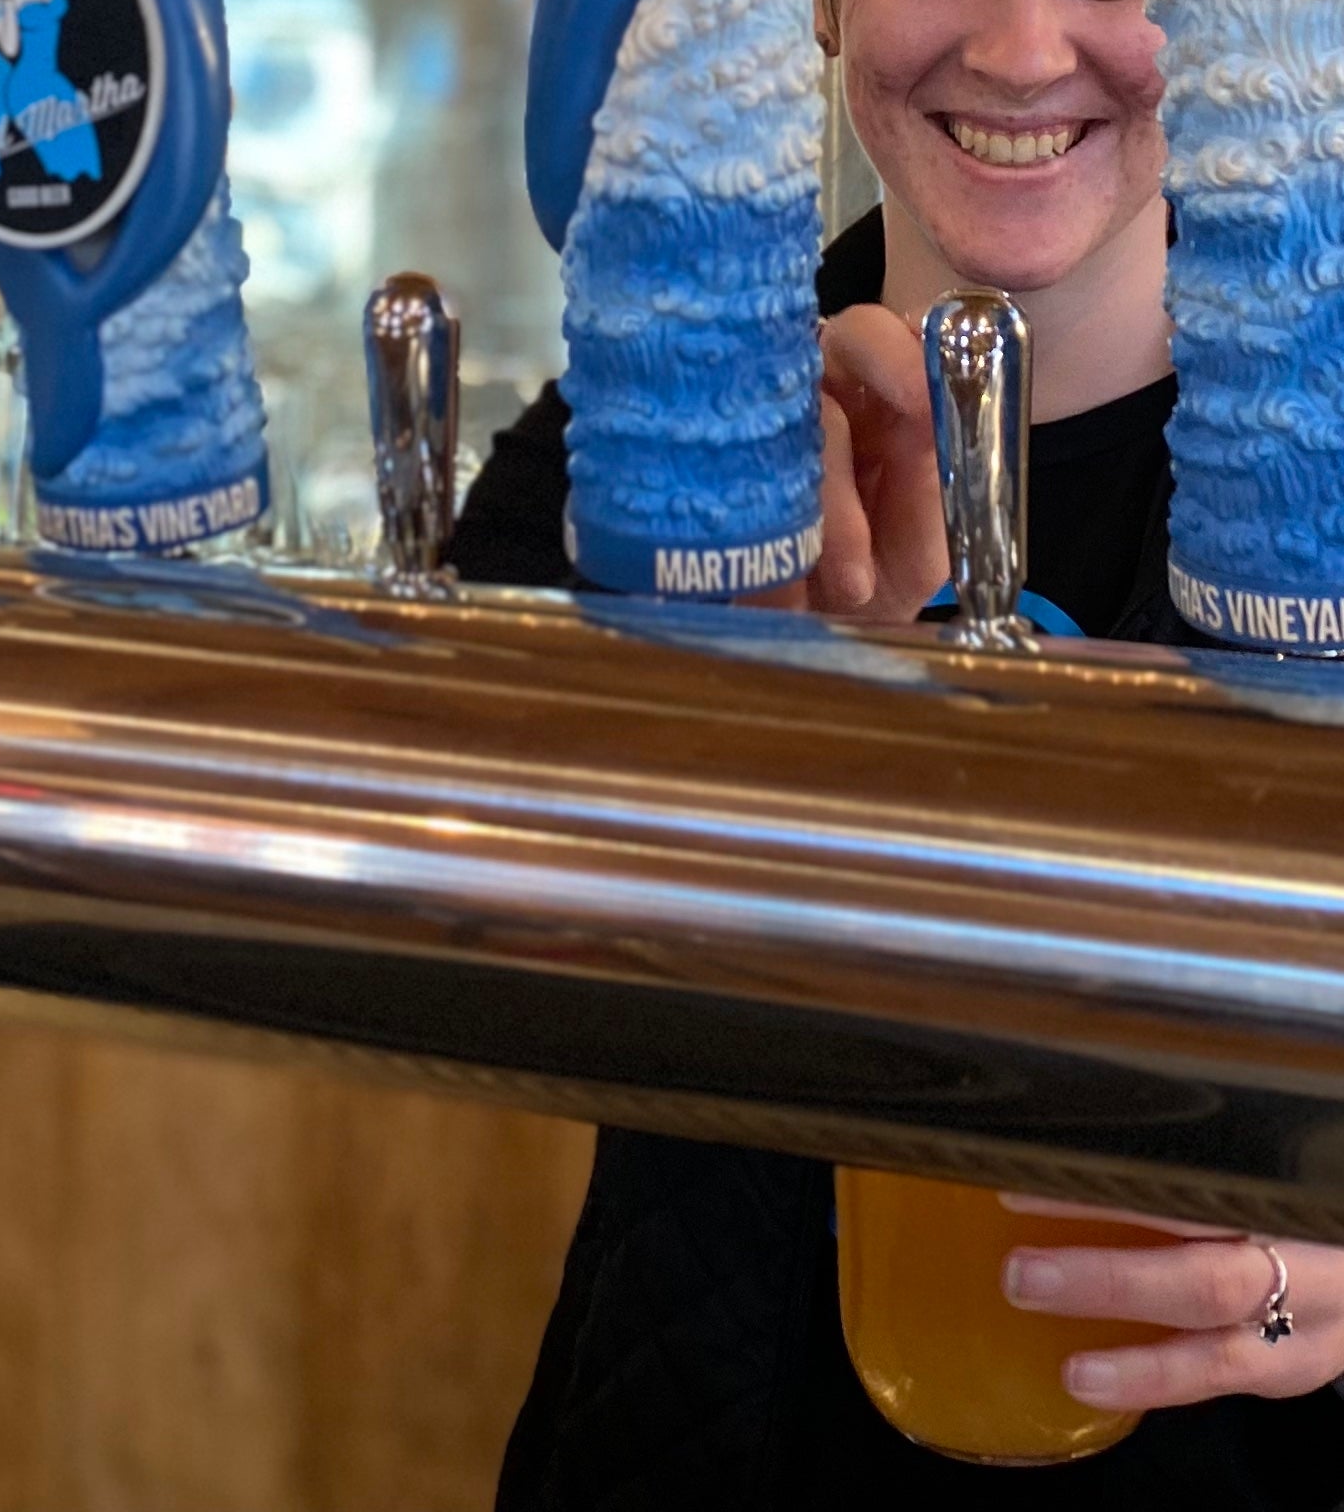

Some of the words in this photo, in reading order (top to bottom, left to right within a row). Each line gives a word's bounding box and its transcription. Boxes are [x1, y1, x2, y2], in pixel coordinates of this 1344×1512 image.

[14, 70, 147, 143] Martha
[137, 477, 259, 545] VINEYARD
[655, 537, 794, 592] MARTHA'S
